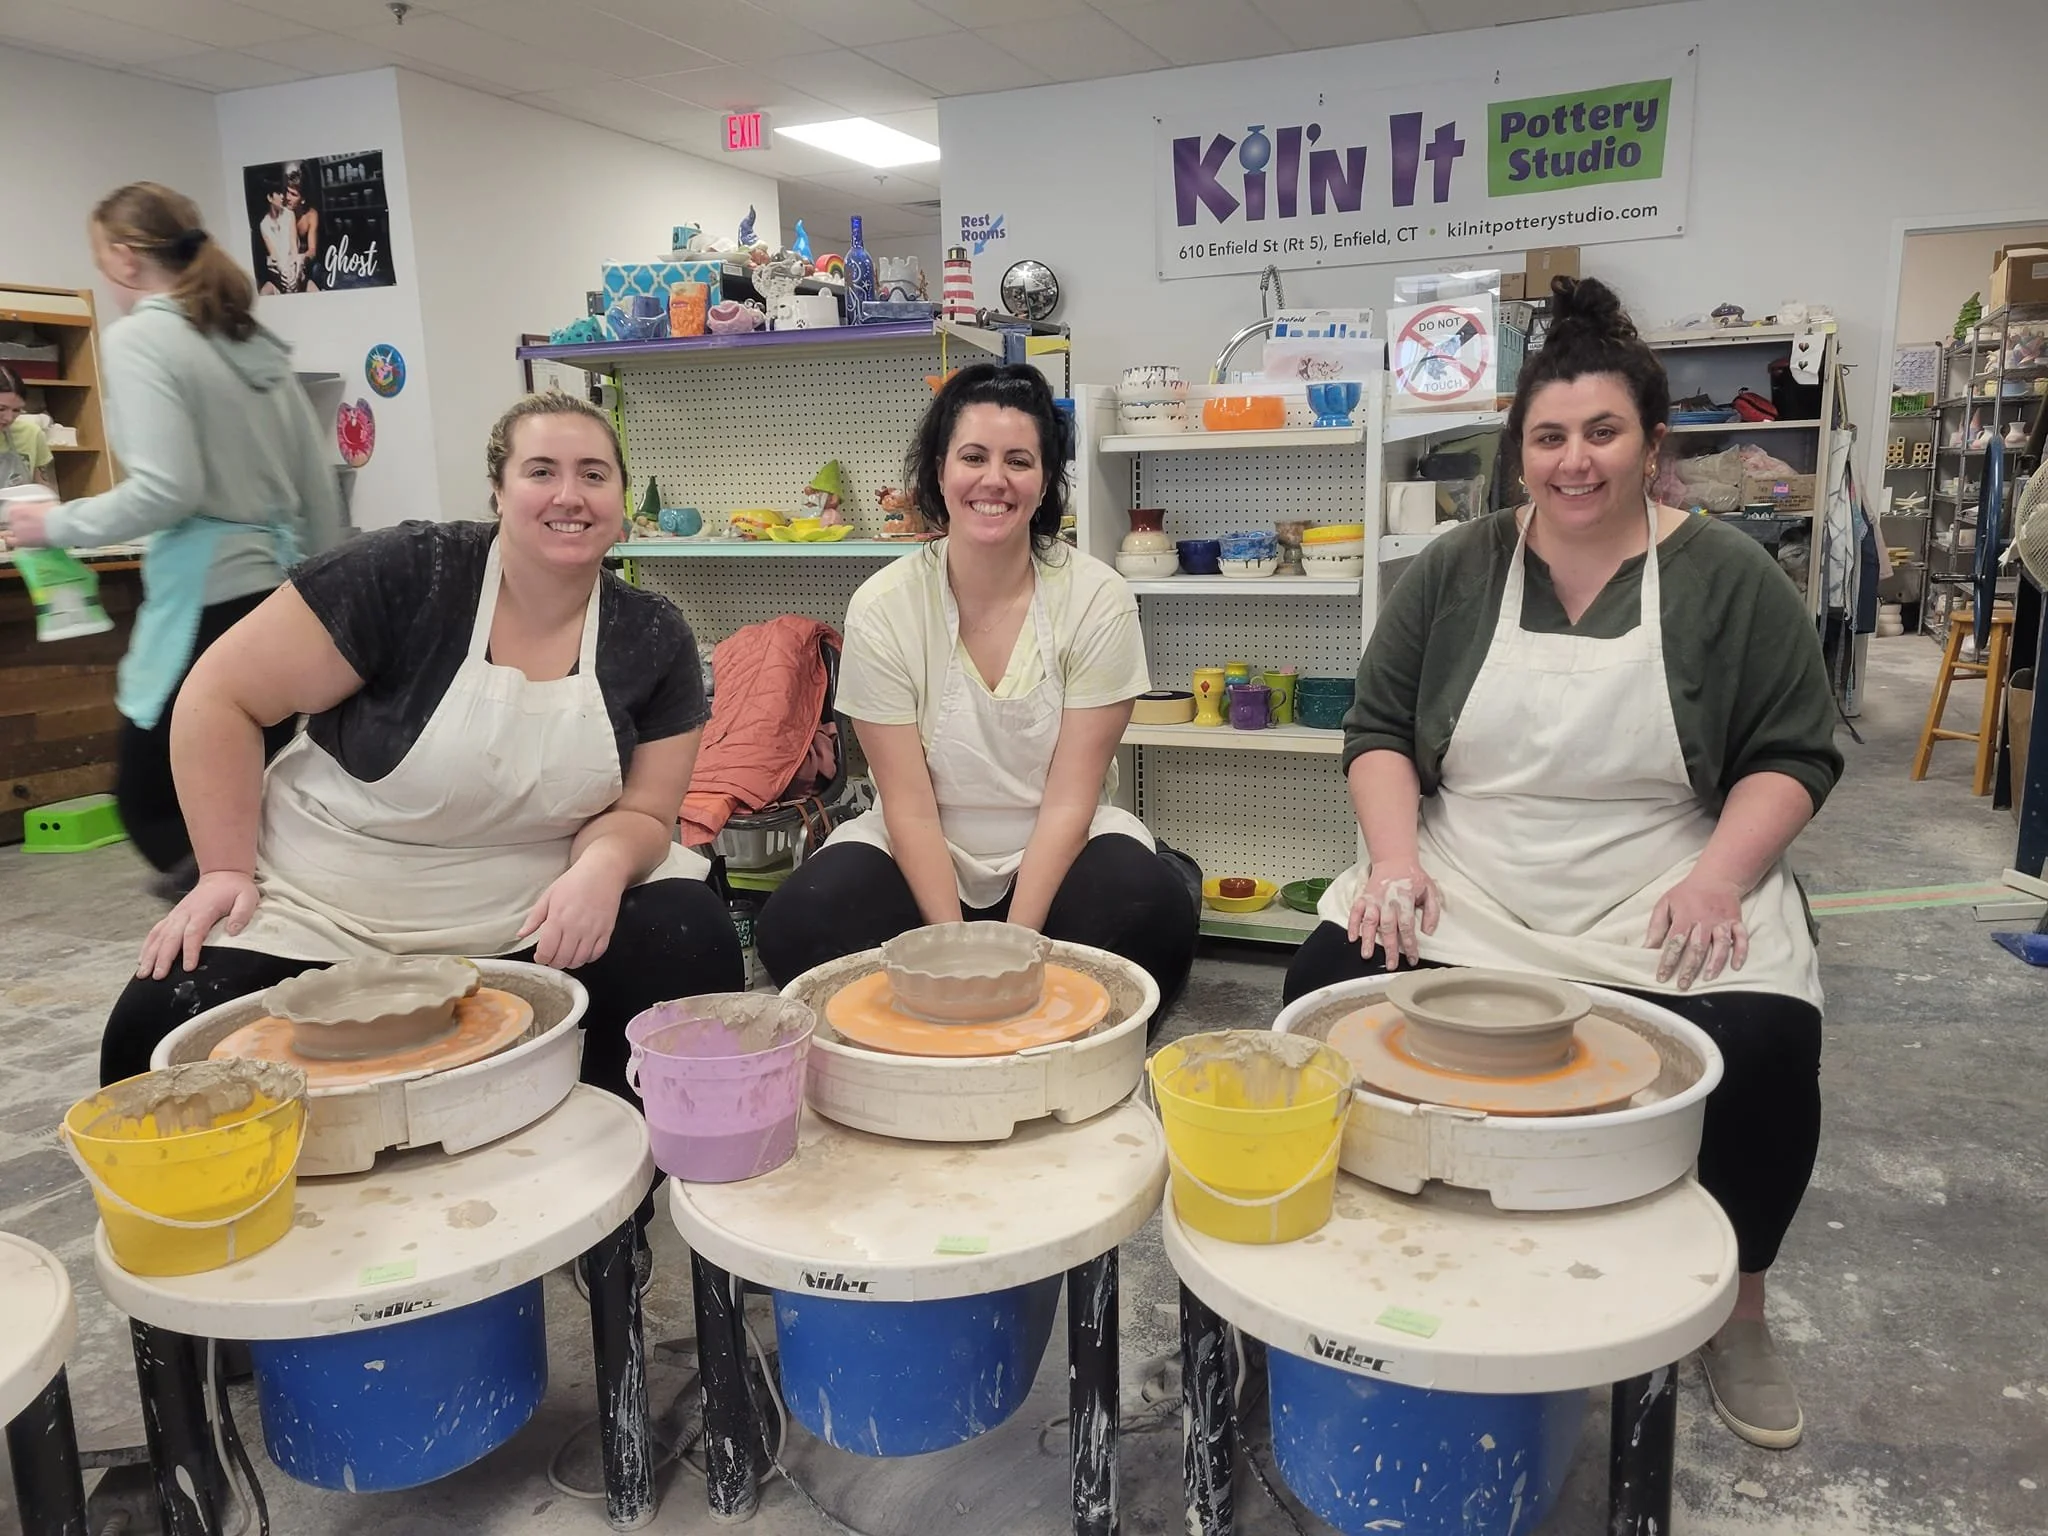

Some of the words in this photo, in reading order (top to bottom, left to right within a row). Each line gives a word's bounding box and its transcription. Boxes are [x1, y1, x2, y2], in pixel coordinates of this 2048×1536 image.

[728, 113, 761, 149] EXIT
[1500, 98, 1659, 143] Pottery
[1389, 111, 1466, 208] It
[1508, 135, 1642, 181] Studio
[961, 213, 990, 228] Rest
[961, 228, 1006, 242] Rooms
[1447, 205, 1659, 238] kilnitpotterystudio.com
[1179, 244, 1205, 260] 610
[1209, 239, 1258, 257] Enfield
[1263, 239, 1279, 253] St
[1283, 237, 1305, 254] (Rt
[1309, 234, 1328, 252] 5),
[1333, 228, 1391, 248] Enfield,
[1397, 226, 1419, 242] CT
[1419, 321, 1435, 332] DO
[1438, 317, 1461, 329] NOT
[1424, 380, 1462, 392] TOUCH
[799, 1270, 878, 1294] Nidec
[1304, 1333, 1394, 1374] Nidec
